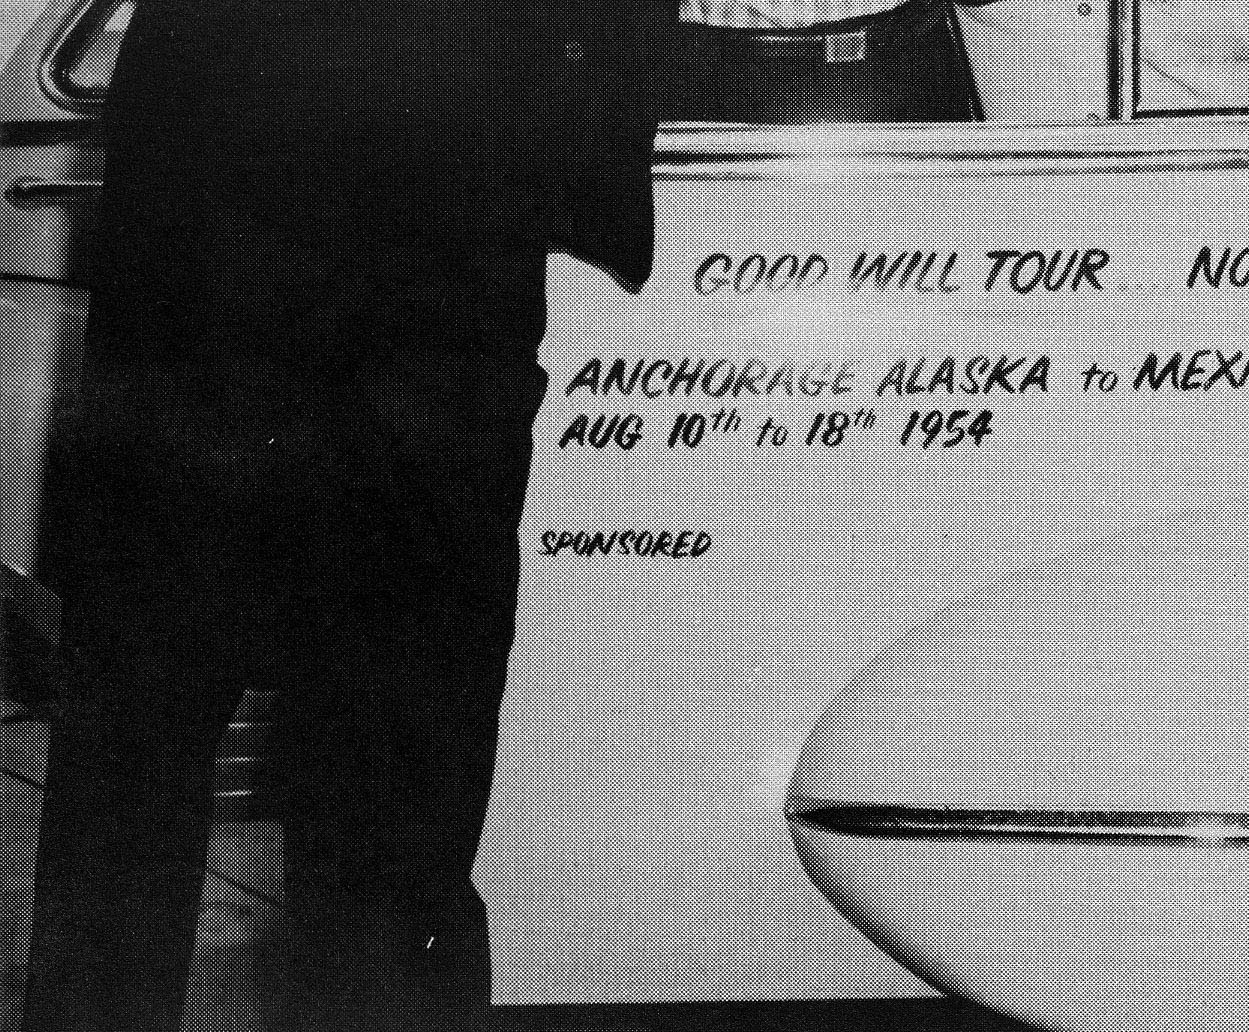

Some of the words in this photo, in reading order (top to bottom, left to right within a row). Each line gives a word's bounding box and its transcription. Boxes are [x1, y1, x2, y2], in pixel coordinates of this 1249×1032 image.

[694, 252, 828, 296] GOOD
[848, 252, 962, 295] WILL
[984, 249, 1110, 294] TOUR
[565, 357, 858, 398] ANCHORAGE
[877, 355, 1052, 395] ALASKA
[1081, 364, 1118, 393] to
[558, 414, 643, 450] AUG
[755, 419, 788, 449] to
[900, 410, 994, 449] 1954
[537, 530, 713, 559] SPONSORED
